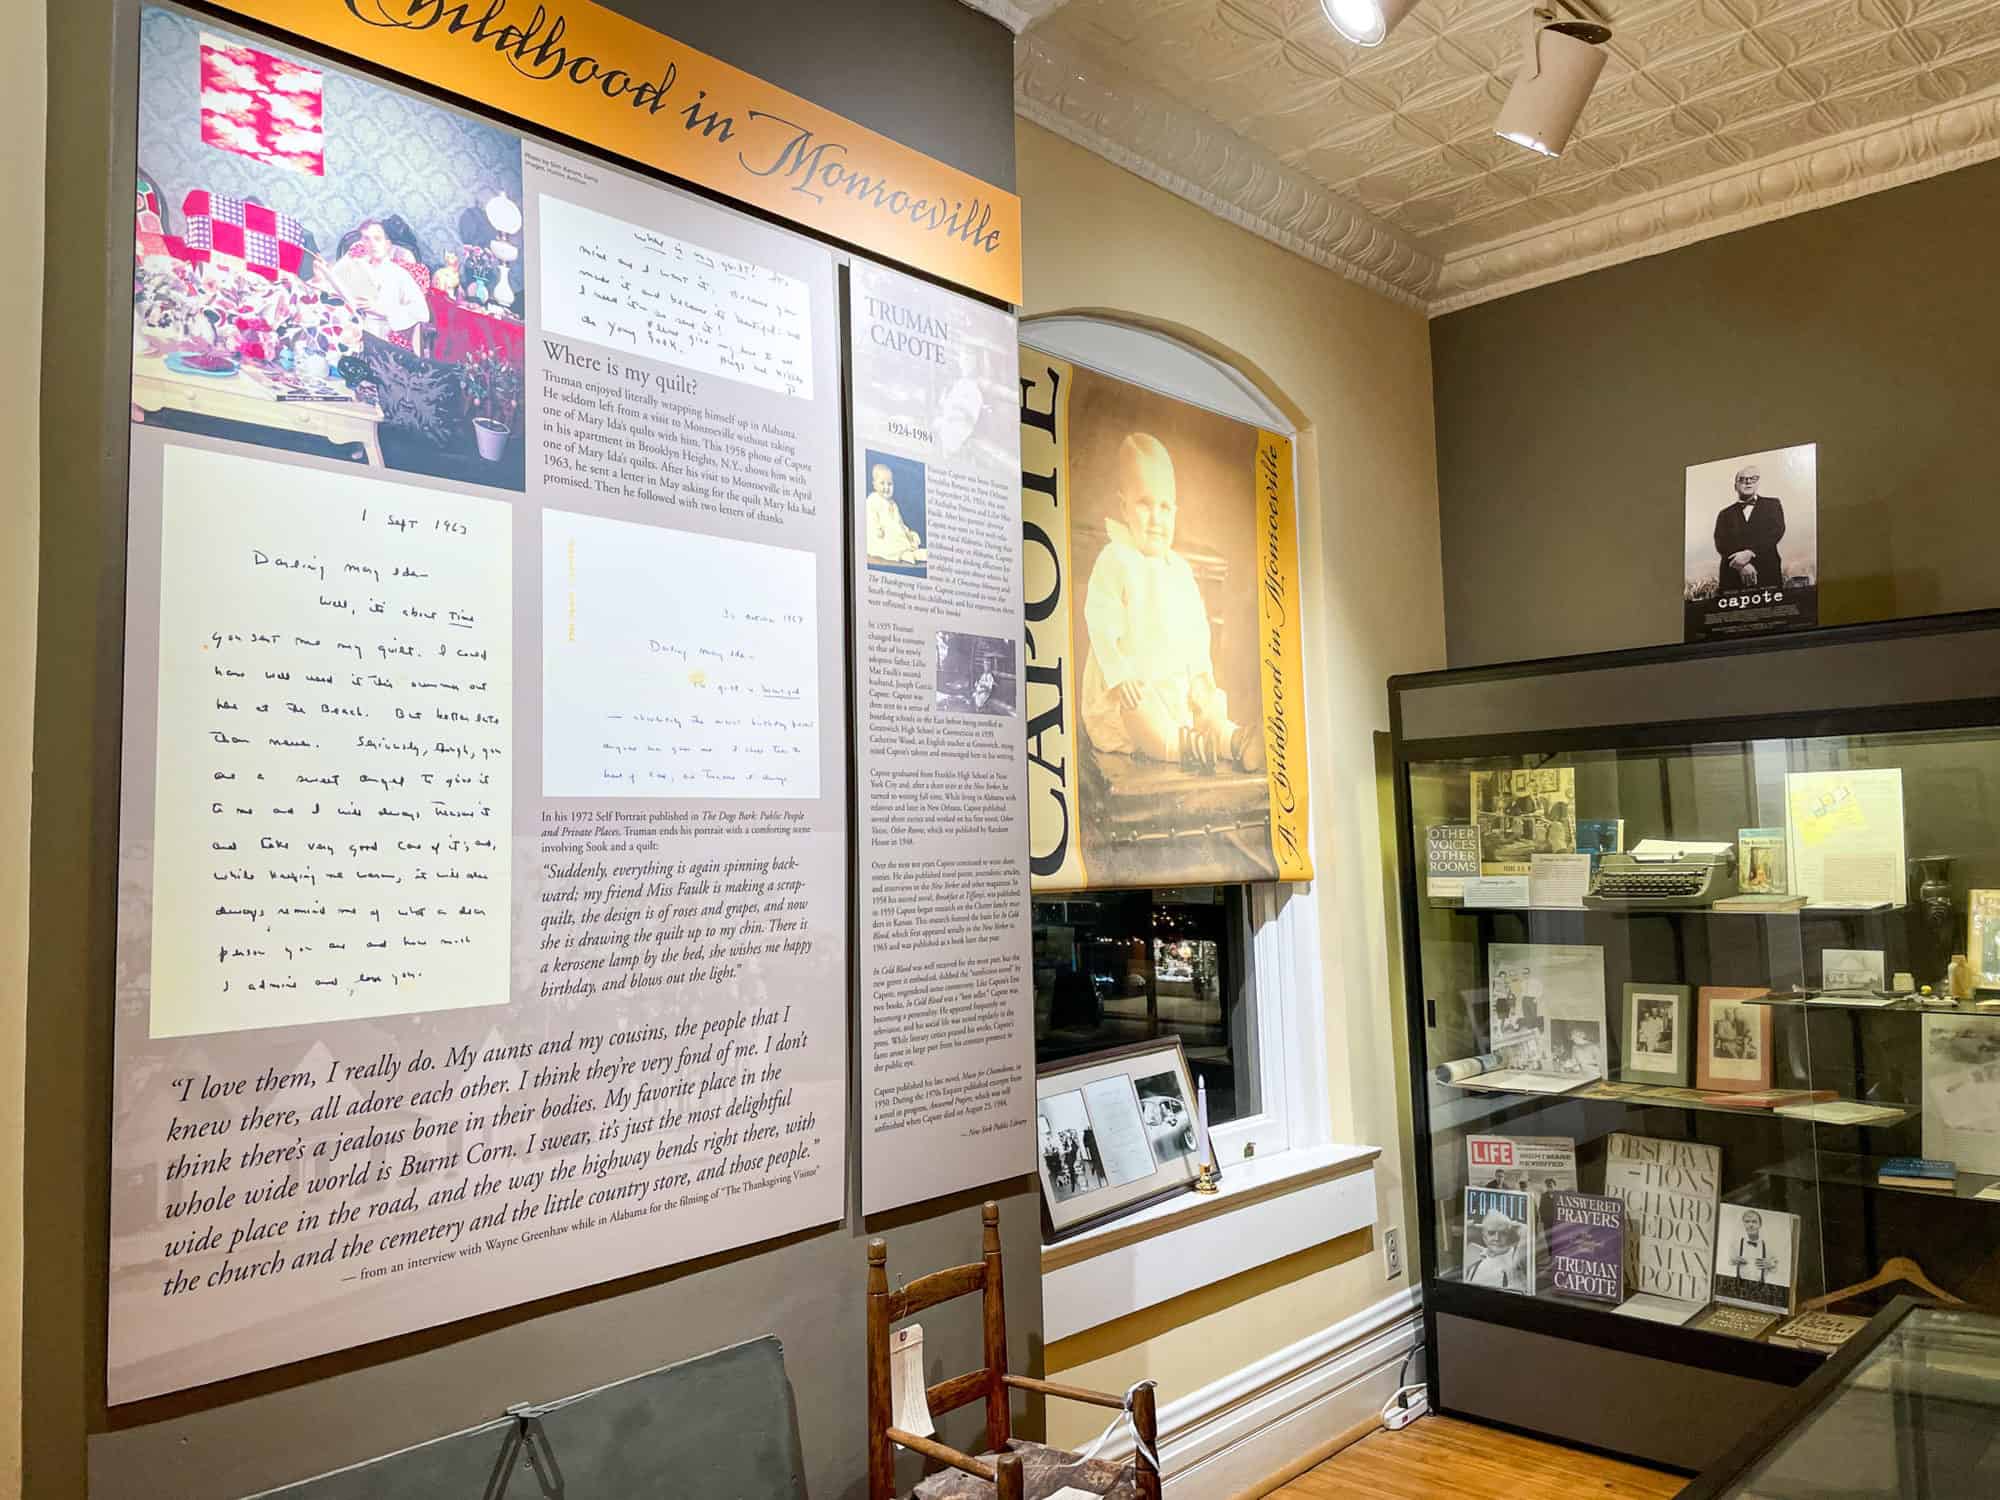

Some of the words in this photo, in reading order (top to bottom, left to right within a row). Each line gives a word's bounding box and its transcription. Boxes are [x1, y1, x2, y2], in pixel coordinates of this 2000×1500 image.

[683, 90, 735, 143] in
[738, 110, 1001, 252] Monroeville
[864, 296, 949, 341] TRUMAN
[870, 324, 946, 365] CAPOTE
[542, 339, 600, 371] Where
[607, 356, 618, 376] is
[625, 367, 650, 388] my
[655, 374, 697, 395] quilt?
[887, 421, 934, 444] 1924-1984
[543, 453, 572, 470] 1963,
[575, 458, 587, 472] he
[589, 465, 609, 476] sent
[611, 470, 617, 478] a
[620, 466, 644, 483] letter
[646, 473, 656, 485] in
[659, 475, 679, 491] May
[681, 481, 709, 498] asking
[711, 486, 724, 498] for
[726, 488, 739, 501] the
[741, 494, 760, 506] quilt
[763, 496, 784, 512] Mary
[787, 500, 799, 512] Ida
[801, 503, 816, 515] had
[1260, 445, 1286, 628] Monroeville
[1718, 590, 1784, 609] capote
[1268, 628, 1282, 656] in
[1264, 659, 1296, 814] Childhood
[1430, 828, 1475, 840] OTHER
[1430, 839, 1477, 850] VOICES
[612, 859, 674, 880] everything
[676, 860, 686, 874] is
[688, 859, 720, 878] again
[722, 857, 769, 877] spinning
[771, 855, 799, 870] back-
[1430, 850, 1475, 861] OTHER
[1430, 861, 1477, 873] ROOMS
[583, 890, 602, 904] my
[602, 882, 644, 904] friend
[646, 882, 673, 897] Miss
[676, 879, 709, 895] Faulk
[712, 880, 721, 893] is
[724, 878, 765, 896] making
[766, 881, 774, 891] a
[776, 879, 805, 894] scrap-
[171, 1076, 195, 1102] "I
[200, 1074, 247, 1099] love
[255, 1066, 316, 1092] them,
[325, 1060, 340, 1083] I
[345, 1052, 401, 1082] really
[407, 1048, 435, 1072] do.
[443, 1044, 477, 1072] My
[482, 1042, 533, 1062] aunts
[537, 1030, 574, 1055] and
[578, 1034, 603, 1055] my
[608, 1023, 667, 1046] cousins,
[674, 1016, 697, 1037] the
[699, 1009, 746, 1040] people
[750, 1007, 778, 1027] that
[783, 1004, 790, 1022] I
[166, 1116, 231, 1142] knew
[239, 1105, 299, 1131] there,
[309, 1094, 341, 1120] all
[345, 1089, 404, 1116] adore
[410, 1079, 453, 1106] each
[459, 1074, 509, 1099] other.
[518, 1069, 528, 1090] I
[533, 1061, 580, 1088] think
[586, 1055, 636, 1083] they're
[641, 1055, 673, 1075] very
[673, 1042, 712, 1073] fond
[715, 1040, 731, 1066] of
[734, 1043, 758, 1058] me.
[764, 1035, 772, 1053] I
[775, 1030, 807, 1051] don't
[165, 1147, 231, 1181] think
[239, 1136, 306, 1168] there's
[312, 1141, 326, 1157] a
[328, 1124, 405, 1162] jealous
[412, 1117, 458, 1140] bone
[465, 1111, 484, 1132] in
[491, 1103, 535, 1127] their
[540, 1093, 596, 1119] bodies.
[603, 1087, 631, 1112] My
[632, 1078, 695, 1110] favorite
[697, 1071, 736, 1099] place
[740, 1068, 755, 1085] in
[760, 1062, 782, 1082] the
[165, 1184, 235, 1219] whole
[244, 1174, 299, 1205] wide
[307, 1160, 371, 1194] world
[376, 1159, 392, 1181] is
[398, 1151, 458, 1177] Burnt
[466, 1142, 516, 1164] Corn.
[525, 1132, 536, 1154] I
[539, 1130, 590, 1151] swear,
[598, 1118, 619, 1140] it's
[620, 1116, 654, 1143] just
[658, 1108, 682, 1129] the
[687, 1104, 721, 1124] most
[725, 1087, 792, 1118] delightful
[1472, 1143, 1511, 1163] LIFE
[1556, 1195, 1621, 1214] ANSWERED
[1556, 1207, 1620, 1229] PRAYERS
[360, 1266, 387, 1280] from
[390, 1263, 403, 1272] an
[407, 1250, 456, 1269] interview
[458, 1241, 481, 1256] with
[484, 1237, 518, 1251] Wayne
[520, 1225, 568, 1242] Greenhaw
[570, 1216, 595, 1231] while
[598, 1215, 607, 1225] in
[609, 1207, 647, 1223] Alabama
[649, 1202, 661, 1213] for
[663, 1199, 677, 1210] the
[678, 1192, 710, 1207] filming
[710, 1188, 720, 1199] of
[741, 1174, 792, 1193] Thanksgiving
[1555, 1255, 1619, 1280] TRUMAN
[1554, 1271, 1618, 1297] CAPOTE
